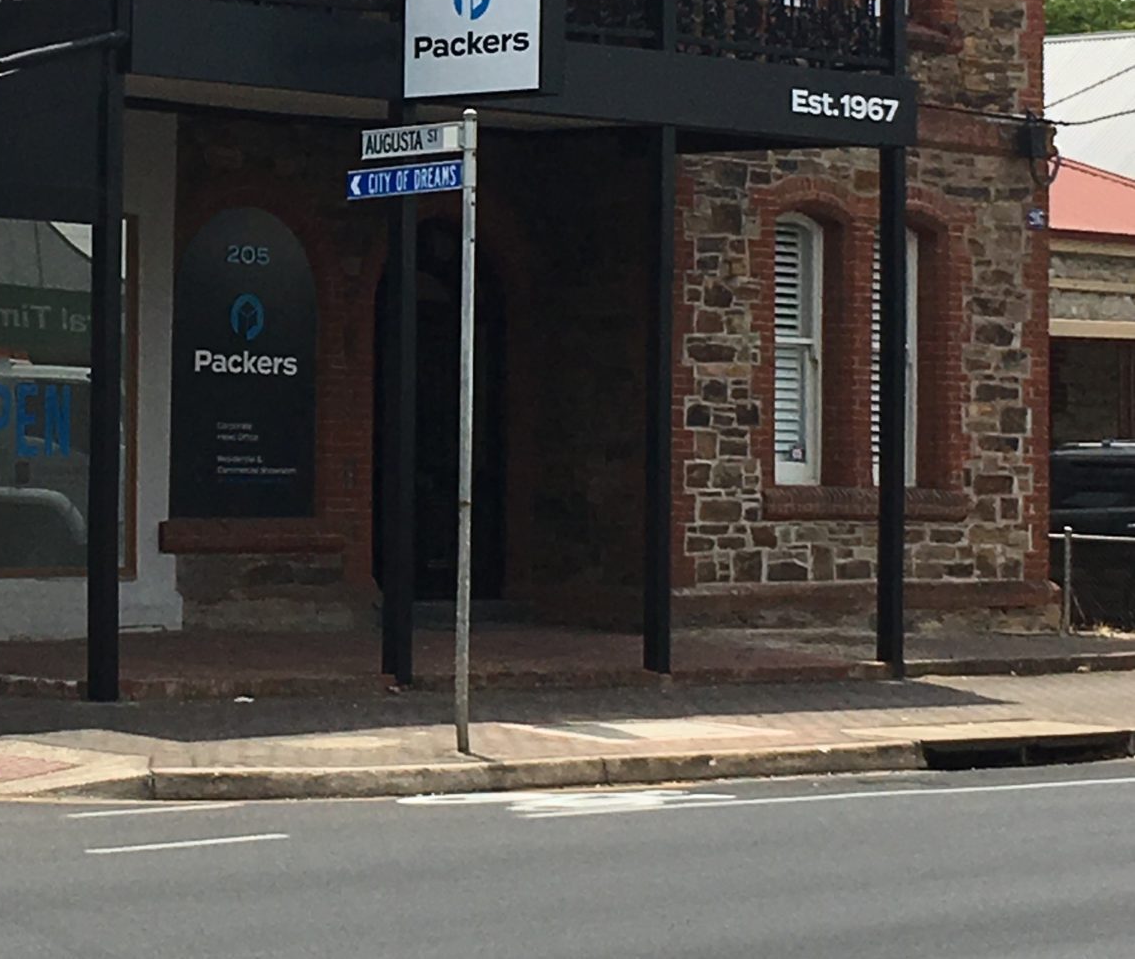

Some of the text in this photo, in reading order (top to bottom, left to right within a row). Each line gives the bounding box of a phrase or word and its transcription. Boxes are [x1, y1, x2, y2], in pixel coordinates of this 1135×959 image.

[414, 31, 529, 59] Packers
[365, 128, 438, 155] AUGUSTA ST
[368, 164, 456, 194] CITY OF DREAMS
[227, 245, 270, 264] 205
[194, 350, 298, 376] Packers
